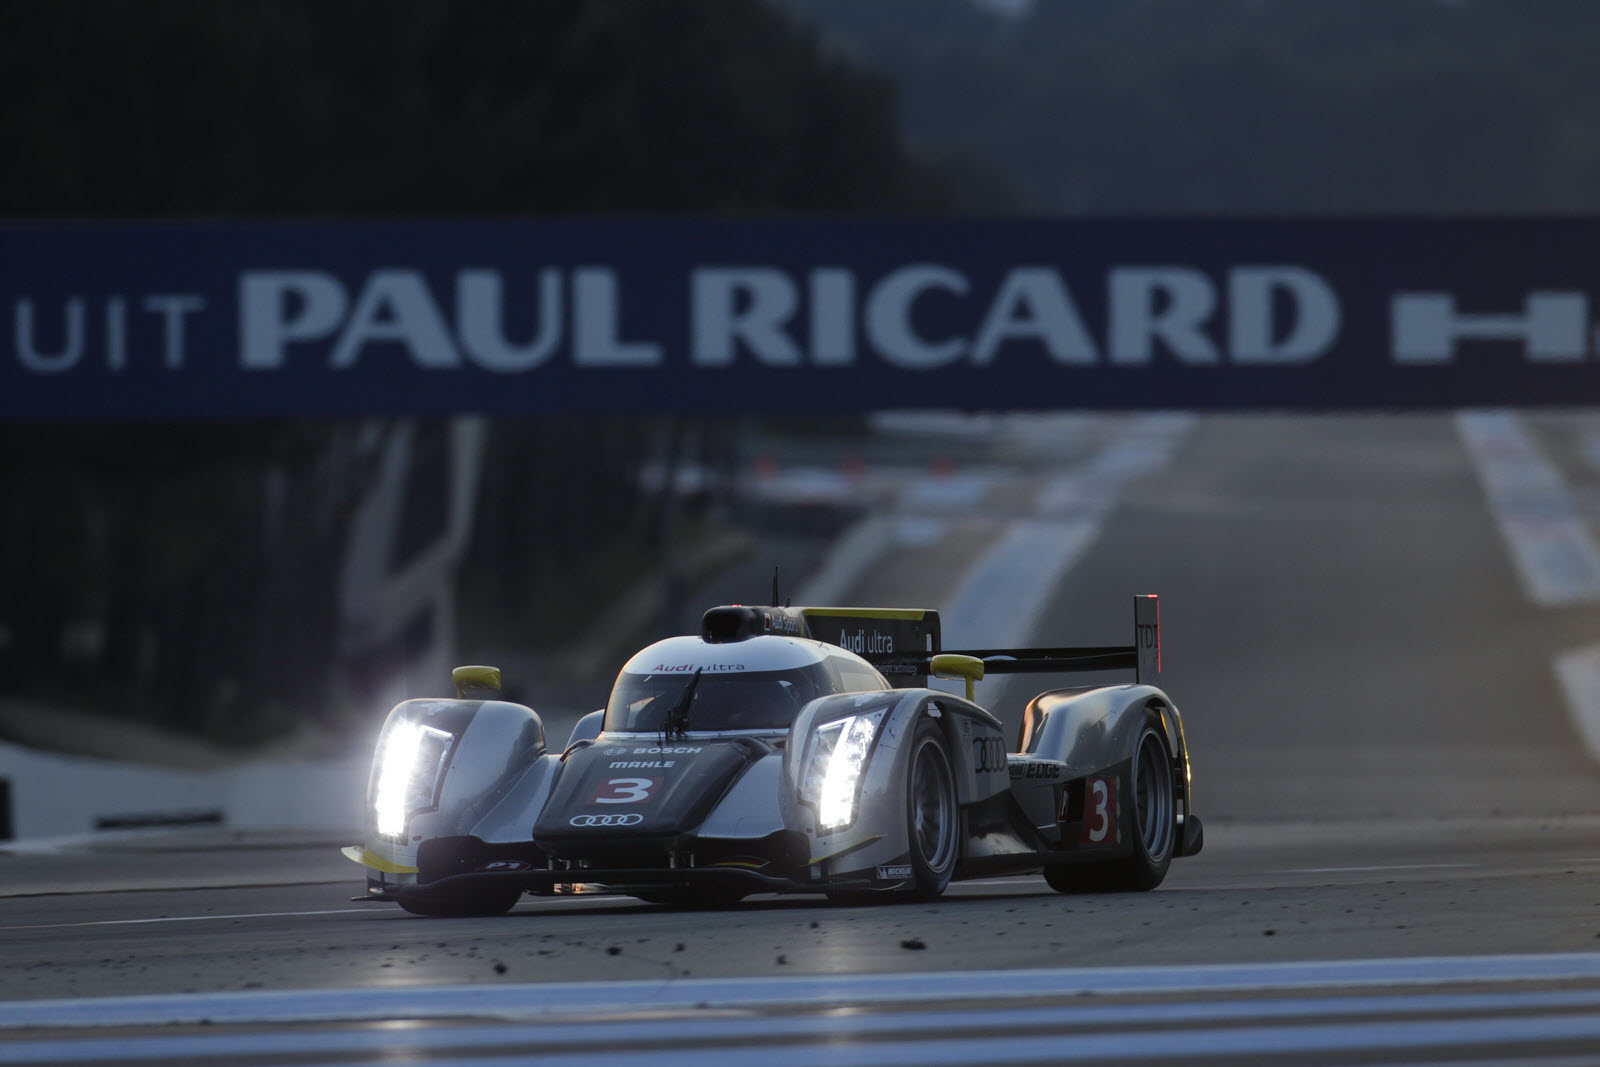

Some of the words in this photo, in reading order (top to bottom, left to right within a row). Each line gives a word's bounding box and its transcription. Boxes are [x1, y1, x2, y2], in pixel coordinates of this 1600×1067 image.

[14, 294, 204, 374] UIT
[238, 268, 662, 373] PAUL
[690, 264, 1341, 368] RICARD
[1391, 291, 1600, 366] H
[840, 628, 865, 653] Audi
[867, 629, 893, 654] ultra
[1137, 623, 1159, 649] TDI
[652, 663, 694, 672] Audi
[698, 663, 746, 672] ultra
[633, 747, 703, 755] BOSCH
[608, 760, 676, 769] MAHLE
[595, 778, 654, 804] 3
[1089, 779, 1109, 842] 3
